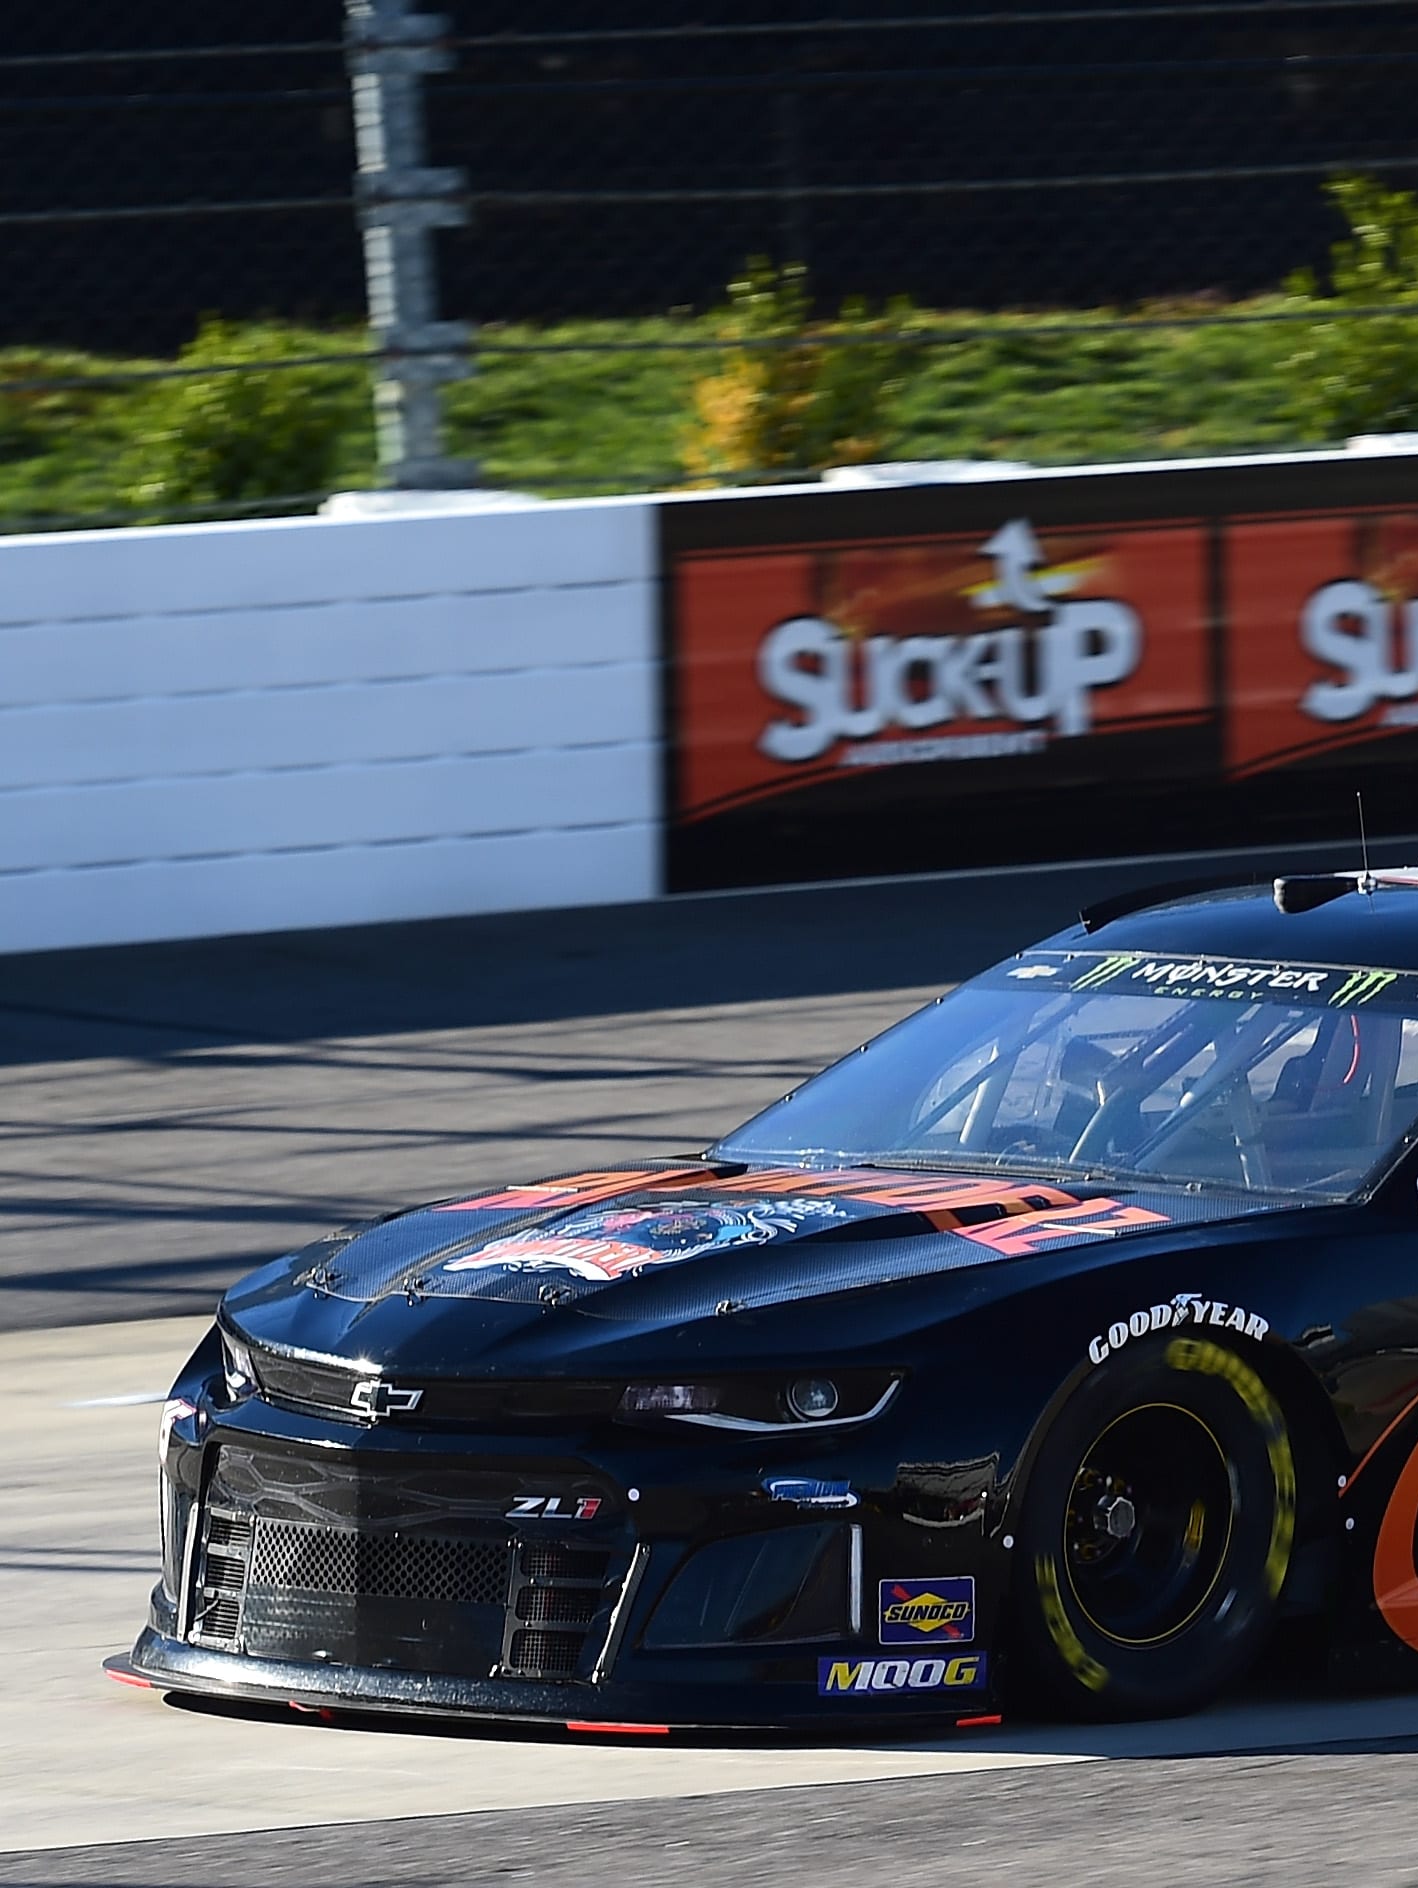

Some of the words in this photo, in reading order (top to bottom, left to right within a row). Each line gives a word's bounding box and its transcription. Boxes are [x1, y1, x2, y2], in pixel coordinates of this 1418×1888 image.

[1154, 986, 1263, 999] ENERGY
[505, 1497, 601, 1519] ZL1
[887, 1604, 967, 1621] SUNOCO
[826, 1656, 979, 1690] MOOG
